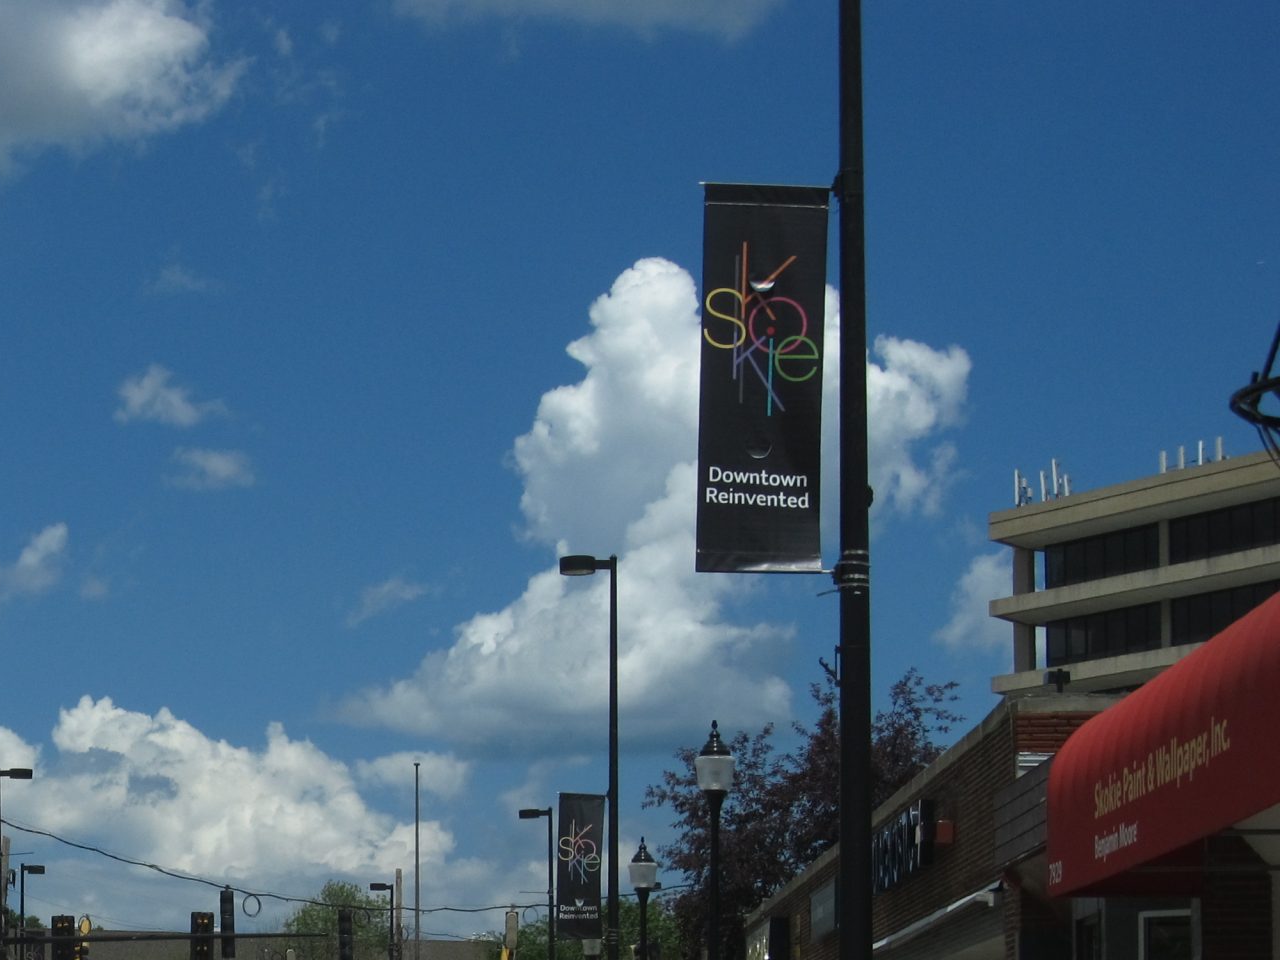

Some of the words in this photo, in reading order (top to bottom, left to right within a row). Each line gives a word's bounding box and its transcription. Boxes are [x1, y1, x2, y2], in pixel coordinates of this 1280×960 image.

[708, 466, 808, 488] Downtown
[705, 486, 810, 509] Reinvented
[1094, 770, 1121, 819] Skokie
[1123, 761, 1147, 804] Paint
[1148, 753, 1155, 792] &
[1210, 716, 1231, 756] Inc.
[1119, 822, 1138, 849] Moore
[1049, 861, 1062, 886] 7929
